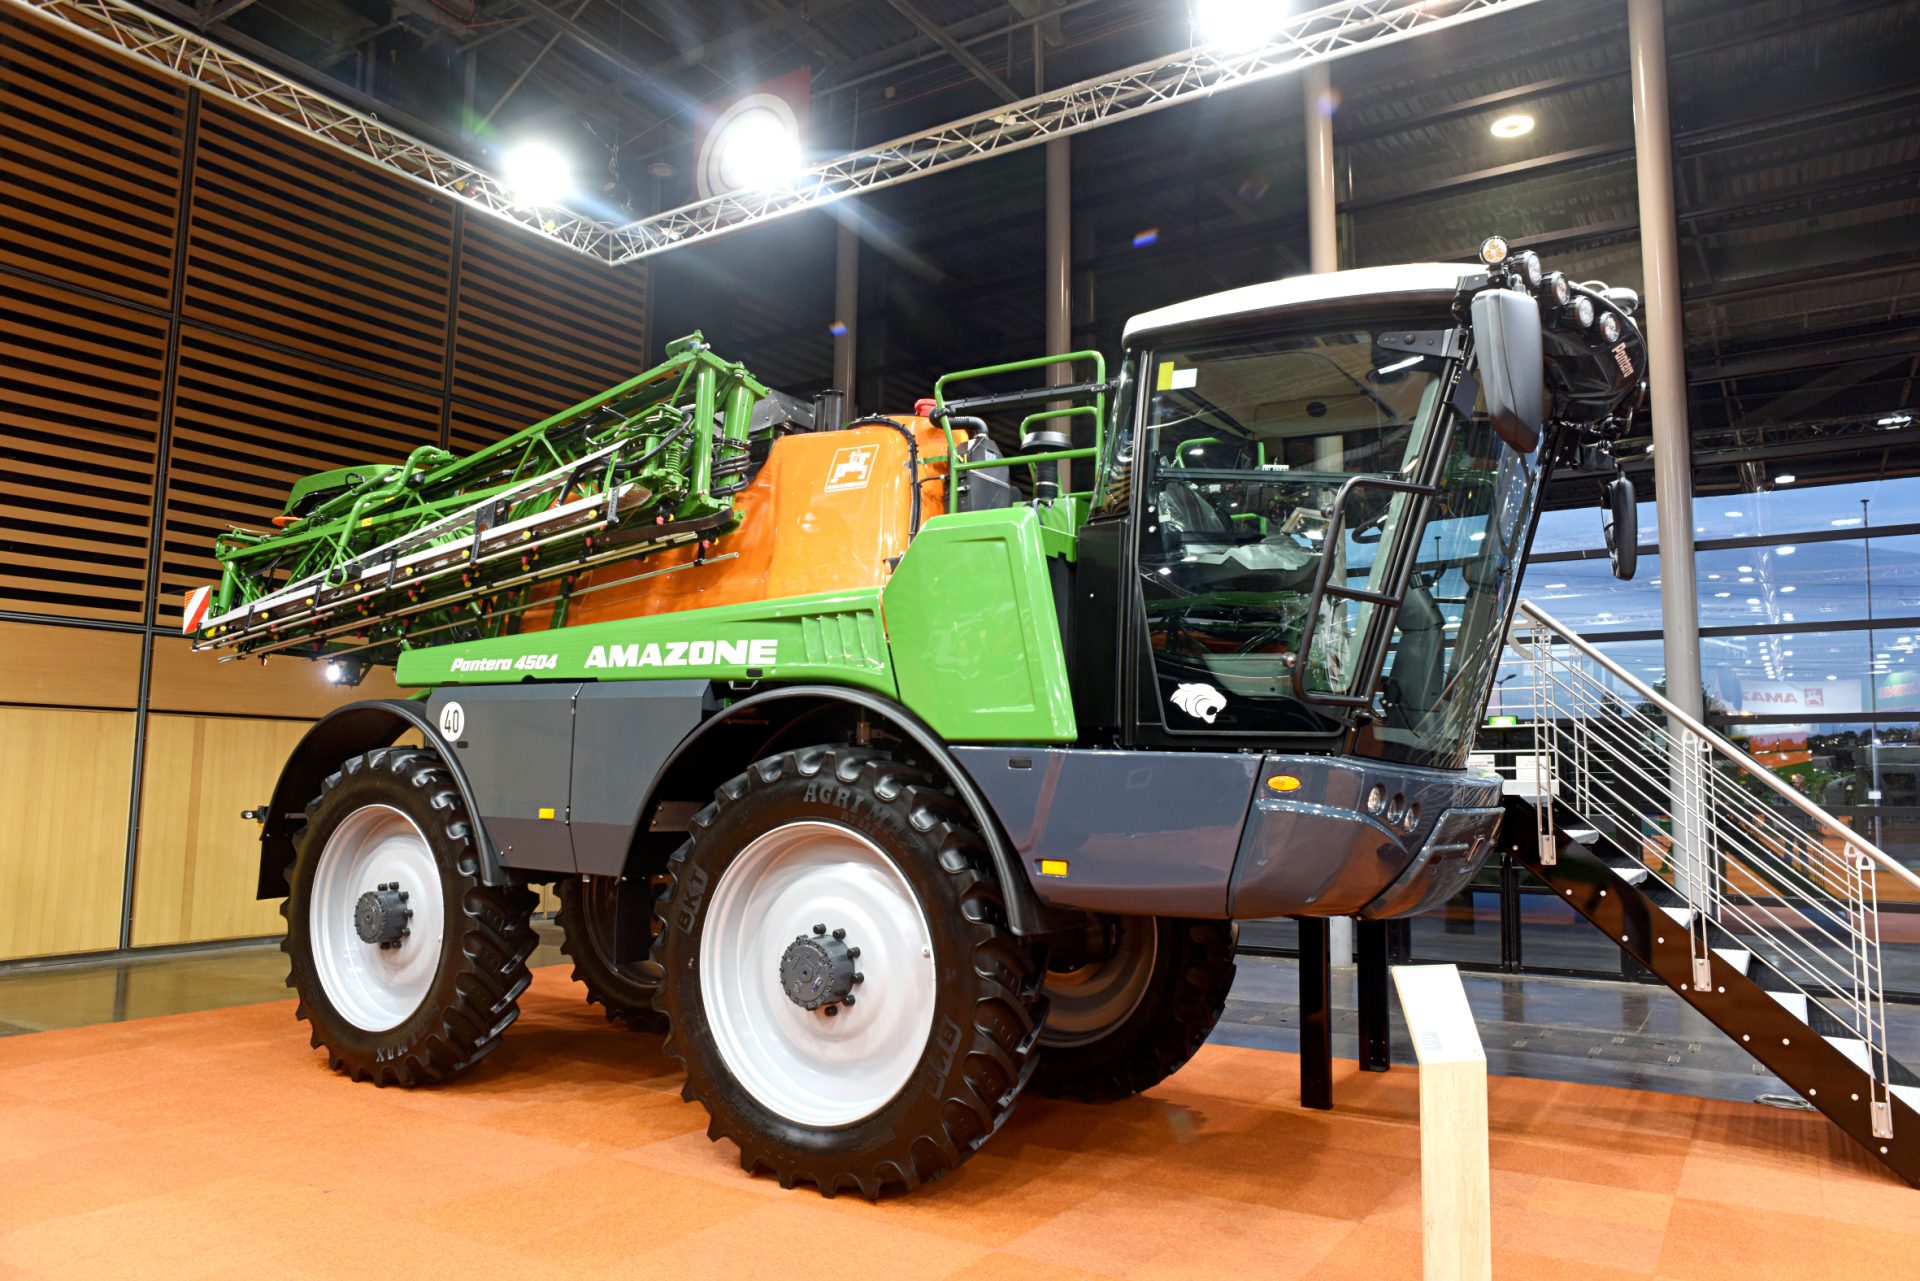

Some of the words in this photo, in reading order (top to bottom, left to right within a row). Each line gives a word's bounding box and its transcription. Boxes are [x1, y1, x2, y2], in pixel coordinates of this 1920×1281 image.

[1611, 342, 1634, 378] Pantera
[450, 657, 512, 672] Pantera
[514, 654, 558, 670] 4504
[584, 639, 778, 668] AMAZONE
[444, 709, 460, 734] 40
[802, 782, 866, 814] AGRI
[677, 865, 708, 935] BKT
